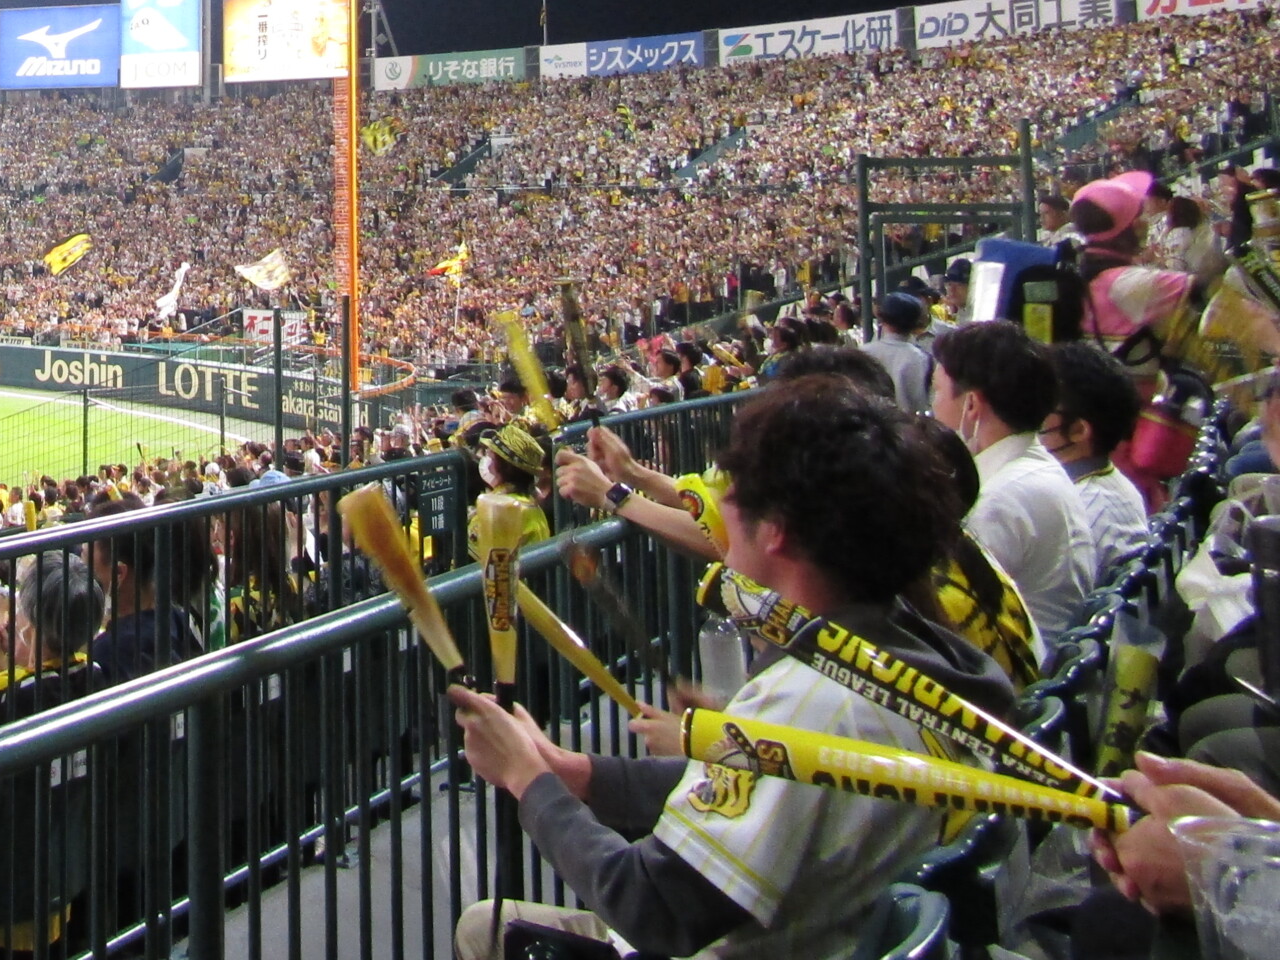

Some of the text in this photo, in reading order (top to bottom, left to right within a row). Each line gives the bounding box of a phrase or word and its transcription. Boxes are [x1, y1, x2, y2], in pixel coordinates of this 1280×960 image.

[257, 14, 269, 61] 一番搾り
[589, 39, 697, 71] シスメックス
[754, 14, 893, 59] エスケー化研
[428, 56, 516, 81] りそな銀行
[35, 349, 123, 389] Joshin
[158, 361, 259, 410] LOTTE
[811, 650, 891, 706] LEAGUE
[897, 694, 996, 768] CENTRAL
